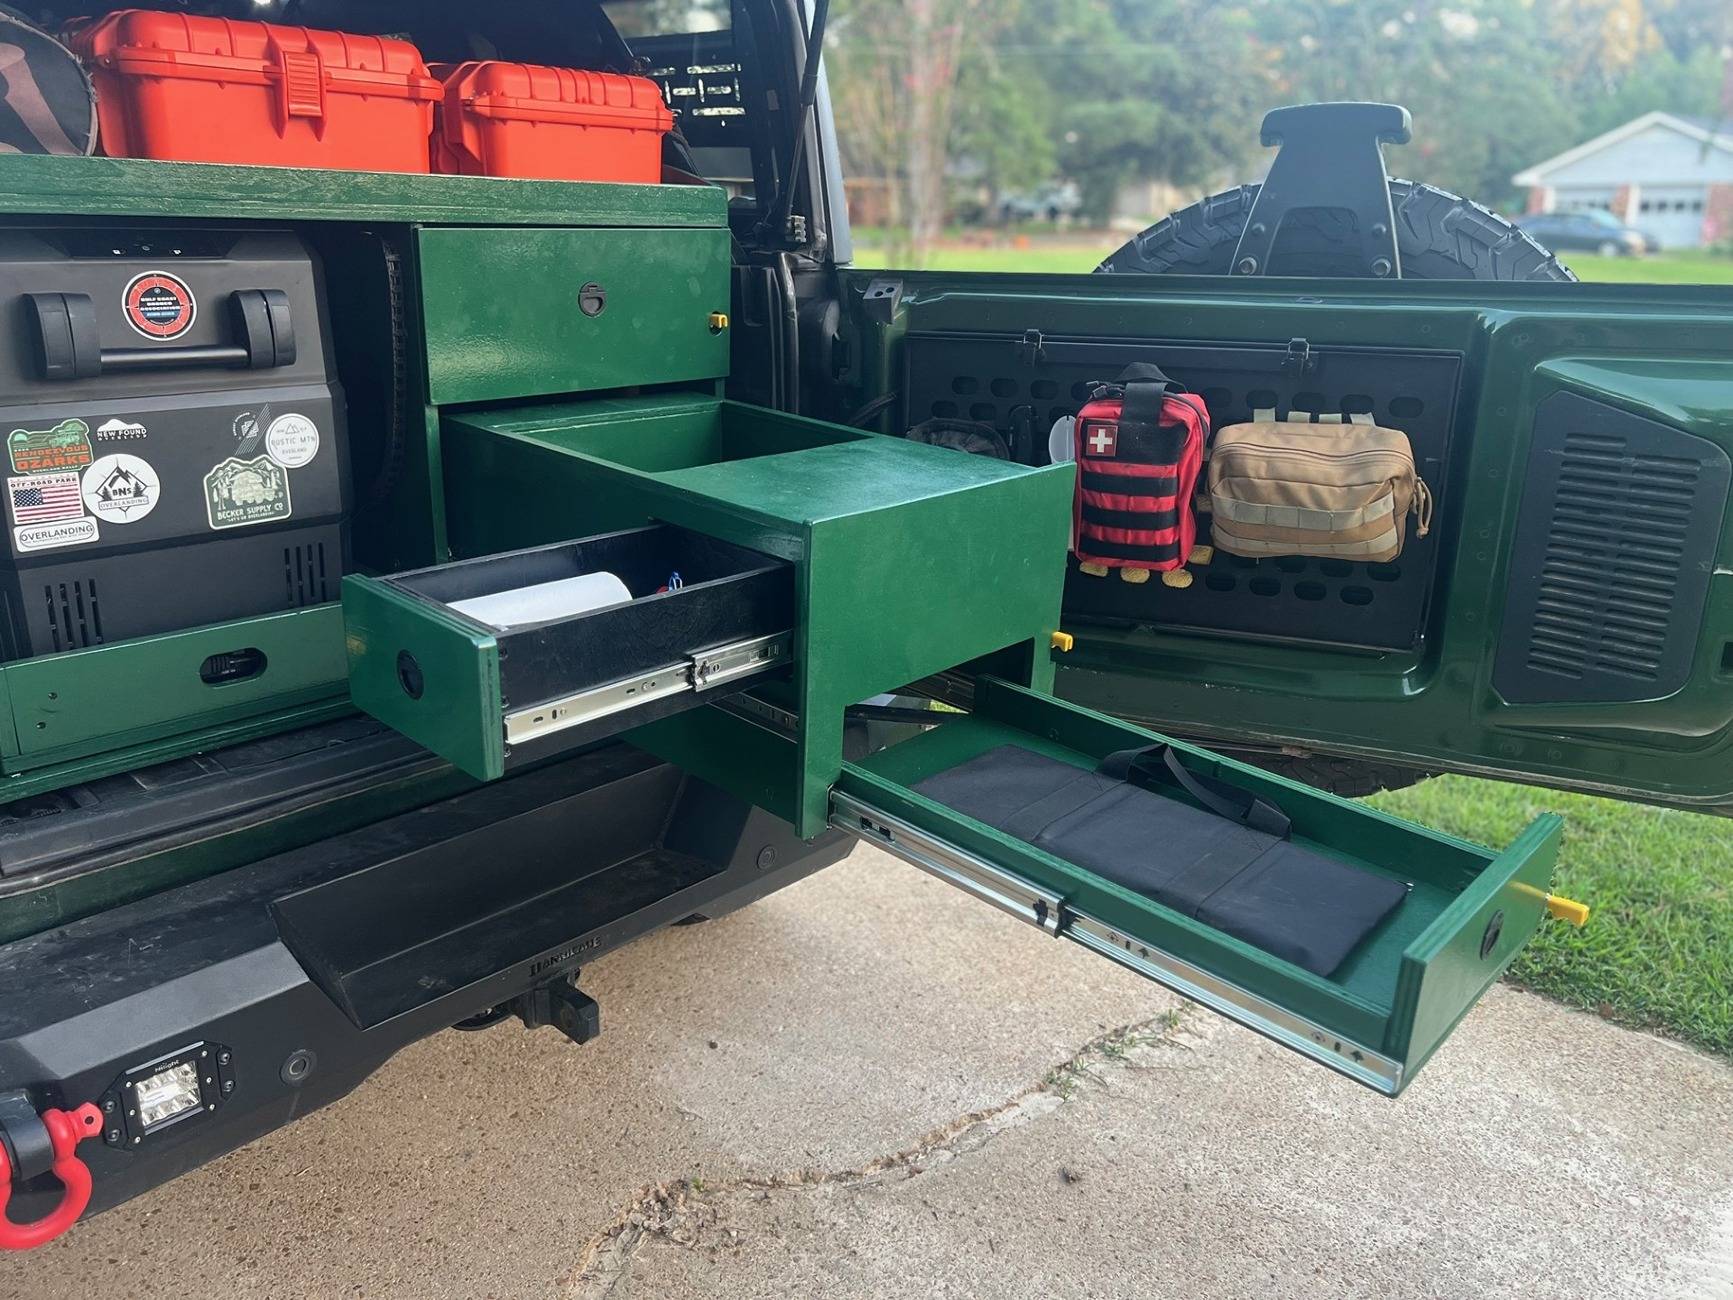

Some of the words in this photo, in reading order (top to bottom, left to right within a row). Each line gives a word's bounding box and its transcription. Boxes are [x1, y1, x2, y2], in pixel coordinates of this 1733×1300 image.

[97, 430, 116, 438] NEW
[118, 428, 147, 437] FOUND
[16, 455, 90, 470] OZARKS
[10, 479, 53, 488] OFF-ROAD
[112, 487, 132, 496] BNS
[100, 498, 148, 509] OVERLANDING
[217, 508, 244, 521] BECKER
[246, 504, 271, 514] SUPPLY
[21, 525, 93, 541] OVERLANDING
